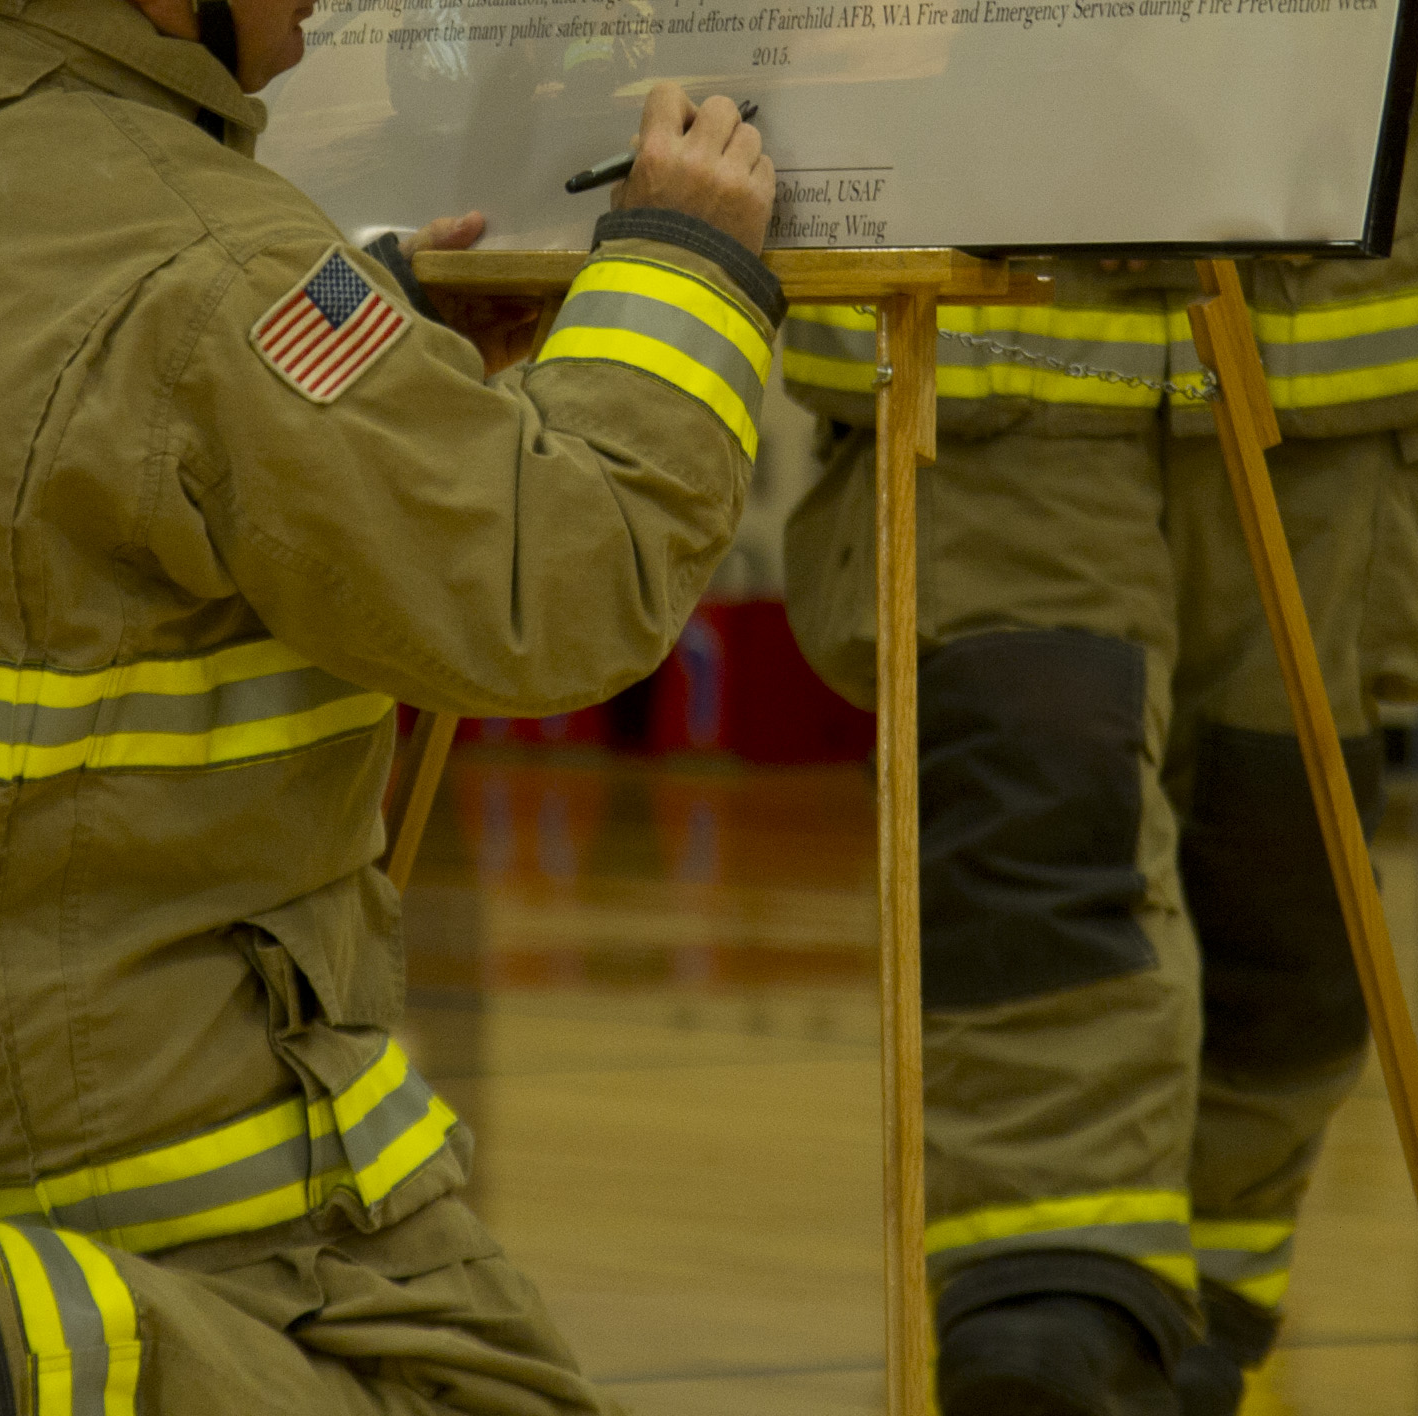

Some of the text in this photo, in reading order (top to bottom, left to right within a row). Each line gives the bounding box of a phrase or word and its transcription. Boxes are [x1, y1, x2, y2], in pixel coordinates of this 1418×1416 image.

[837, 178, 885, 202] USAF
[770, 213, 887, 247] Refueling Wing
